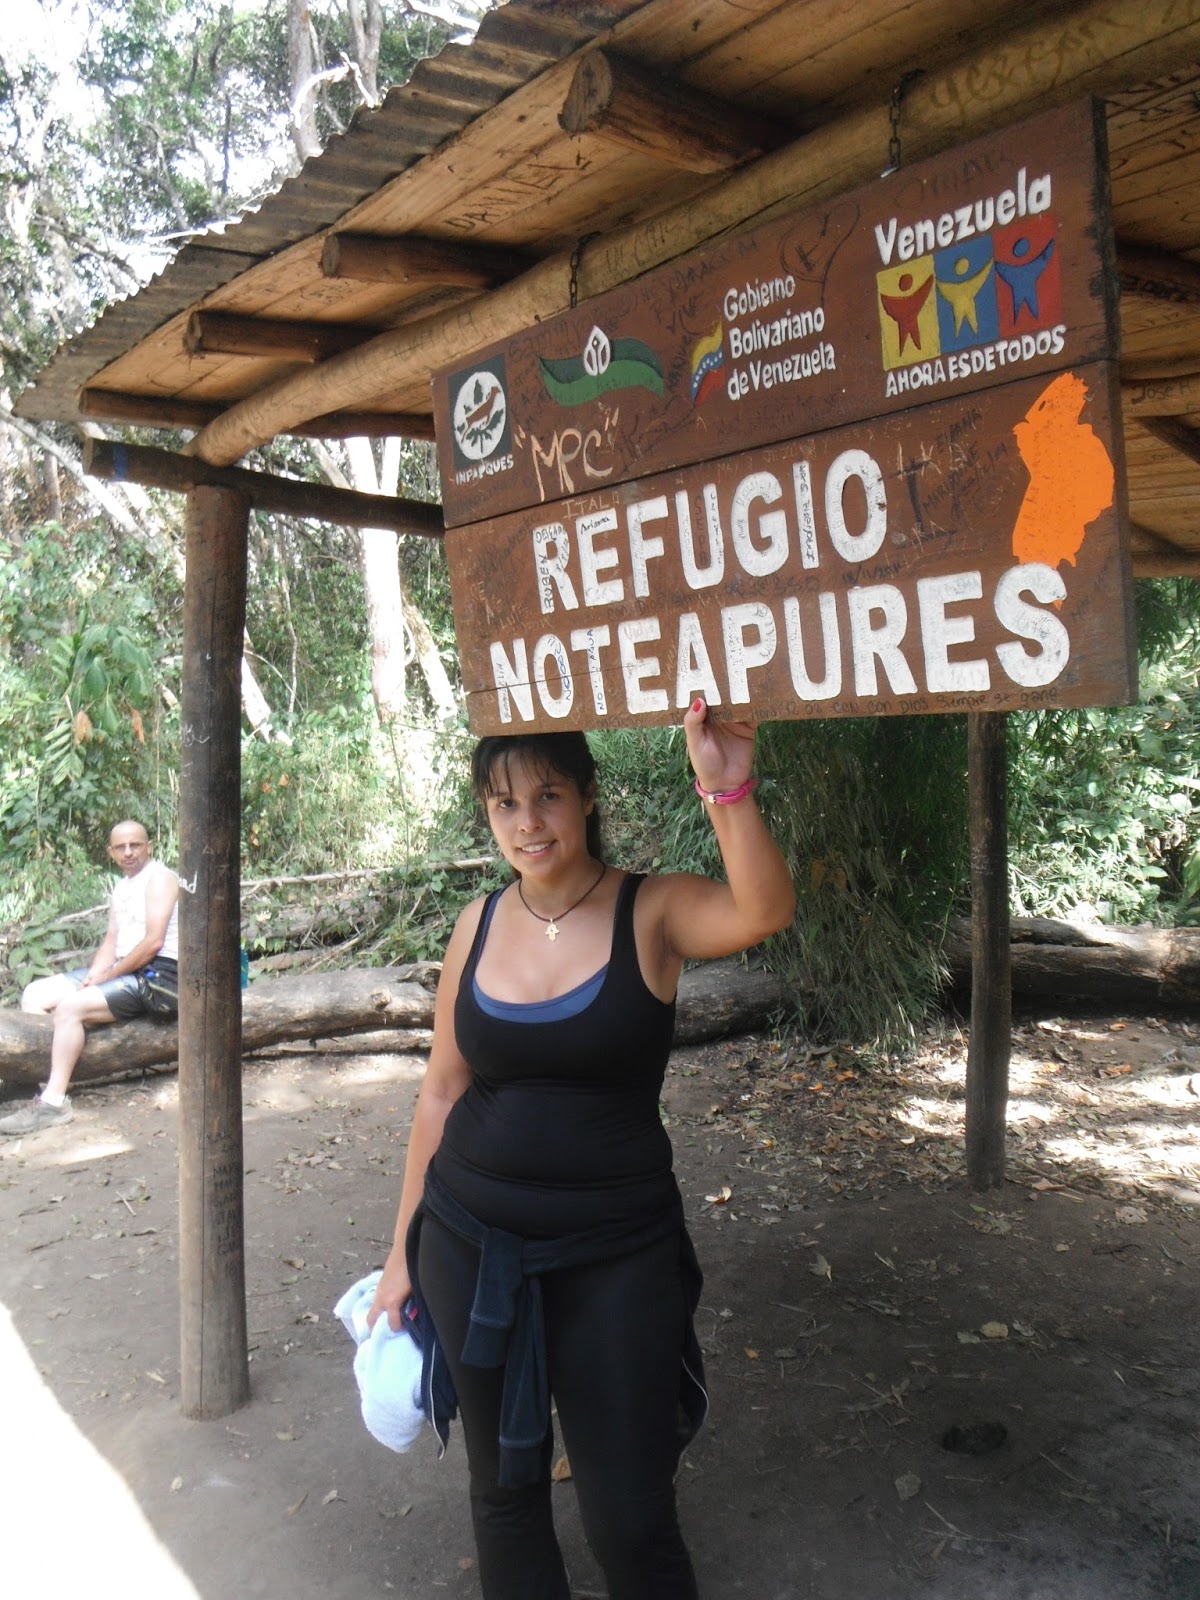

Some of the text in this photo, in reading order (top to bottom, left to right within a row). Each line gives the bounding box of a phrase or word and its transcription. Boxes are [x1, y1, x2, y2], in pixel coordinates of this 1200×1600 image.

[874, 166, 1052, 265] Venezuela
[723, 275, 796, 322] Gobierno
[729, 306, 825, 359] Bolivariano
[727, 341, 836, 401] de Venezuela
[885, 356, 946, 398] AHORA
[533, 448, 888, 615] REFUGIO
